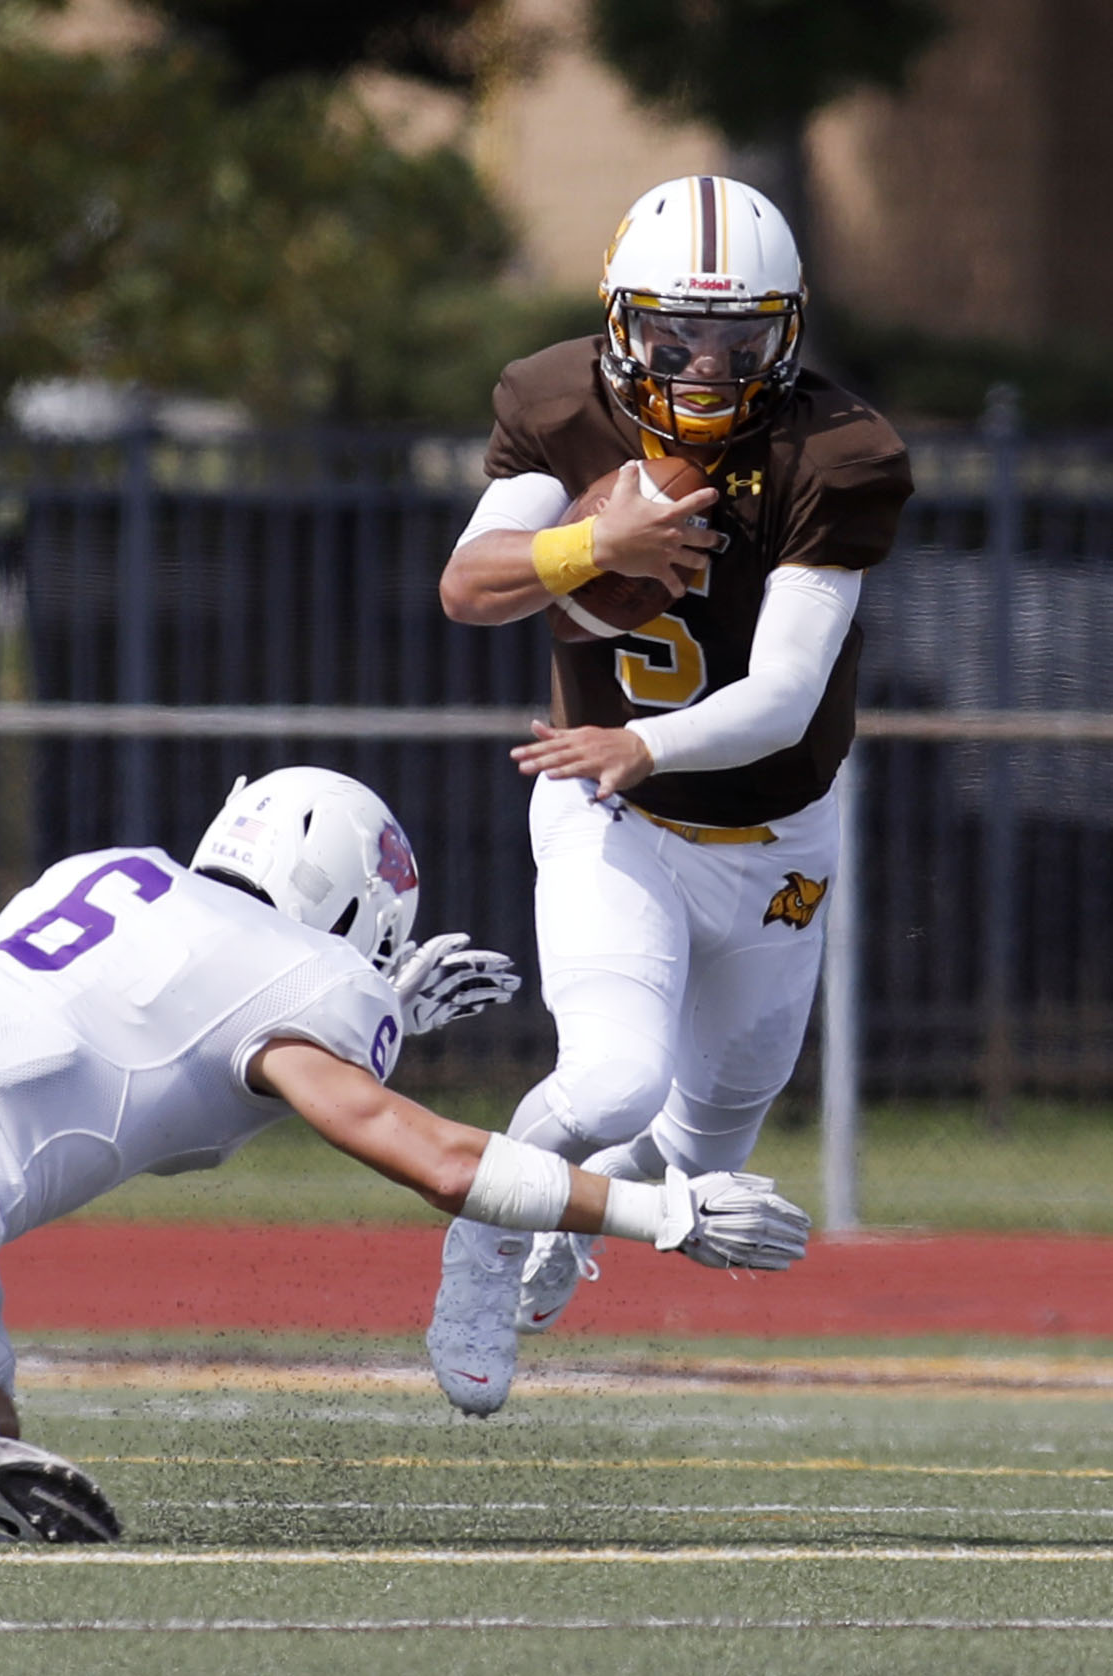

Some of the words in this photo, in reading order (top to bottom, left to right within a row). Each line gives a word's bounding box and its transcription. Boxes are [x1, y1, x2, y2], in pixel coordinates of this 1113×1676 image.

[689, 278, 732, 290] Riddell
[614, 558, 711, 708] 5
[256, 797, 271, 811] 6
[370, 1015, 397, 1079] 6
